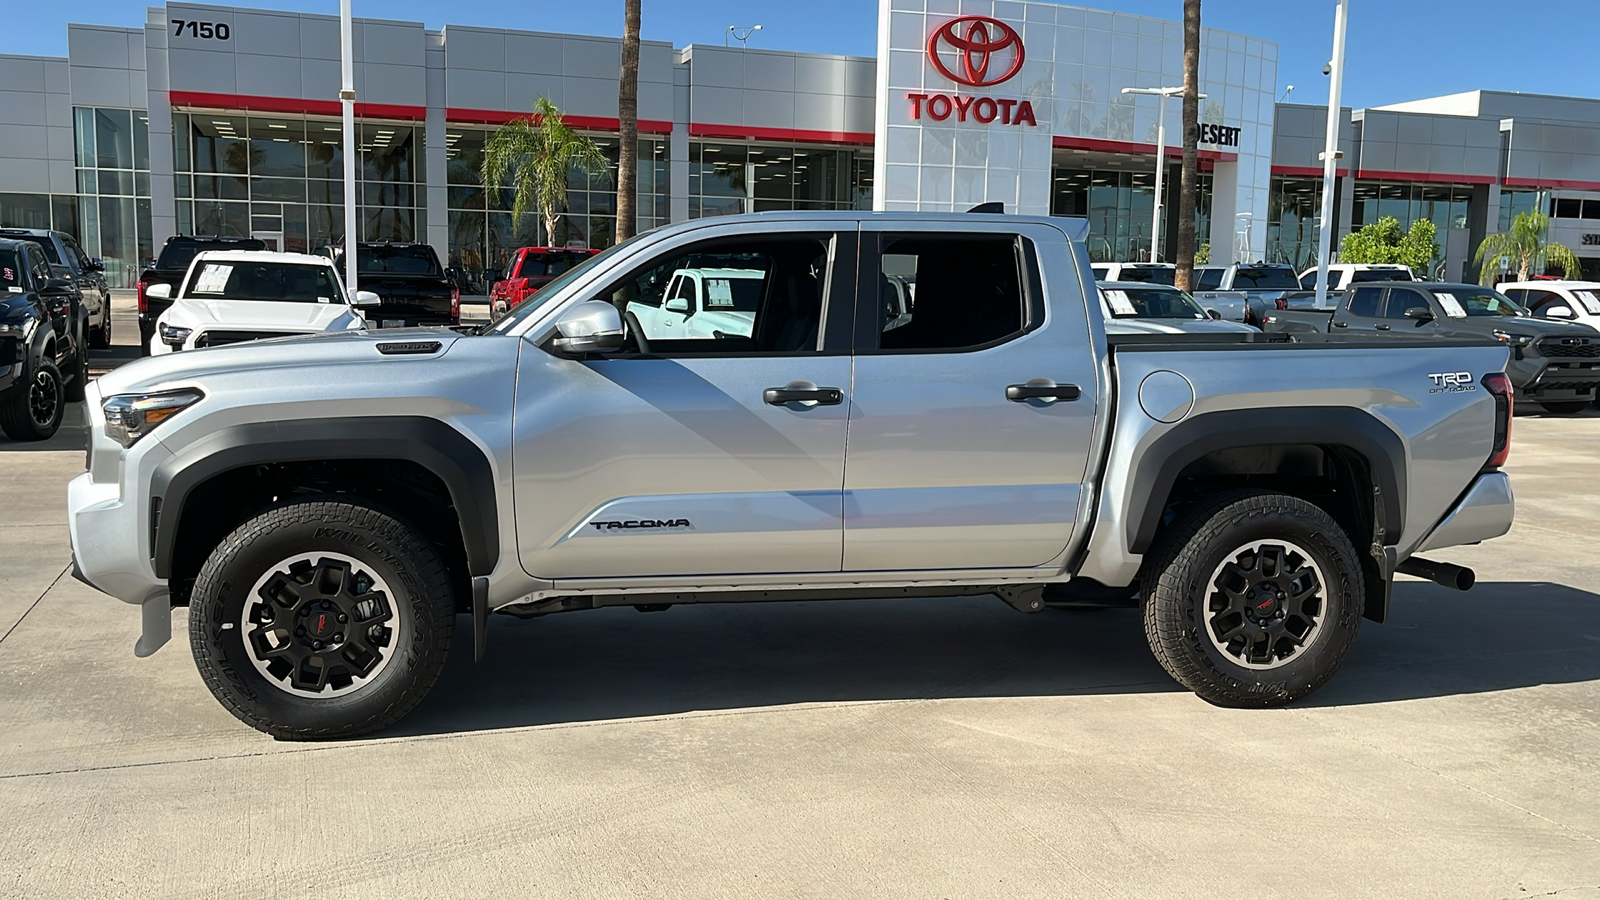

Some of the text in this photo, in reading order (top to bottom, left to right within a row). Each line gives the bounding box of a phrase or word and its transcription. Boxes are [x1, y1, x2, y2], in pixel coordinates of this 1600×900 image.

[171, 19, 230, 40] 7150
[906, 93, 1037, 126] TOYOTA
[1428, 371, 1473, 387] TRD
[589, 519, 690, 530] TACOMA
